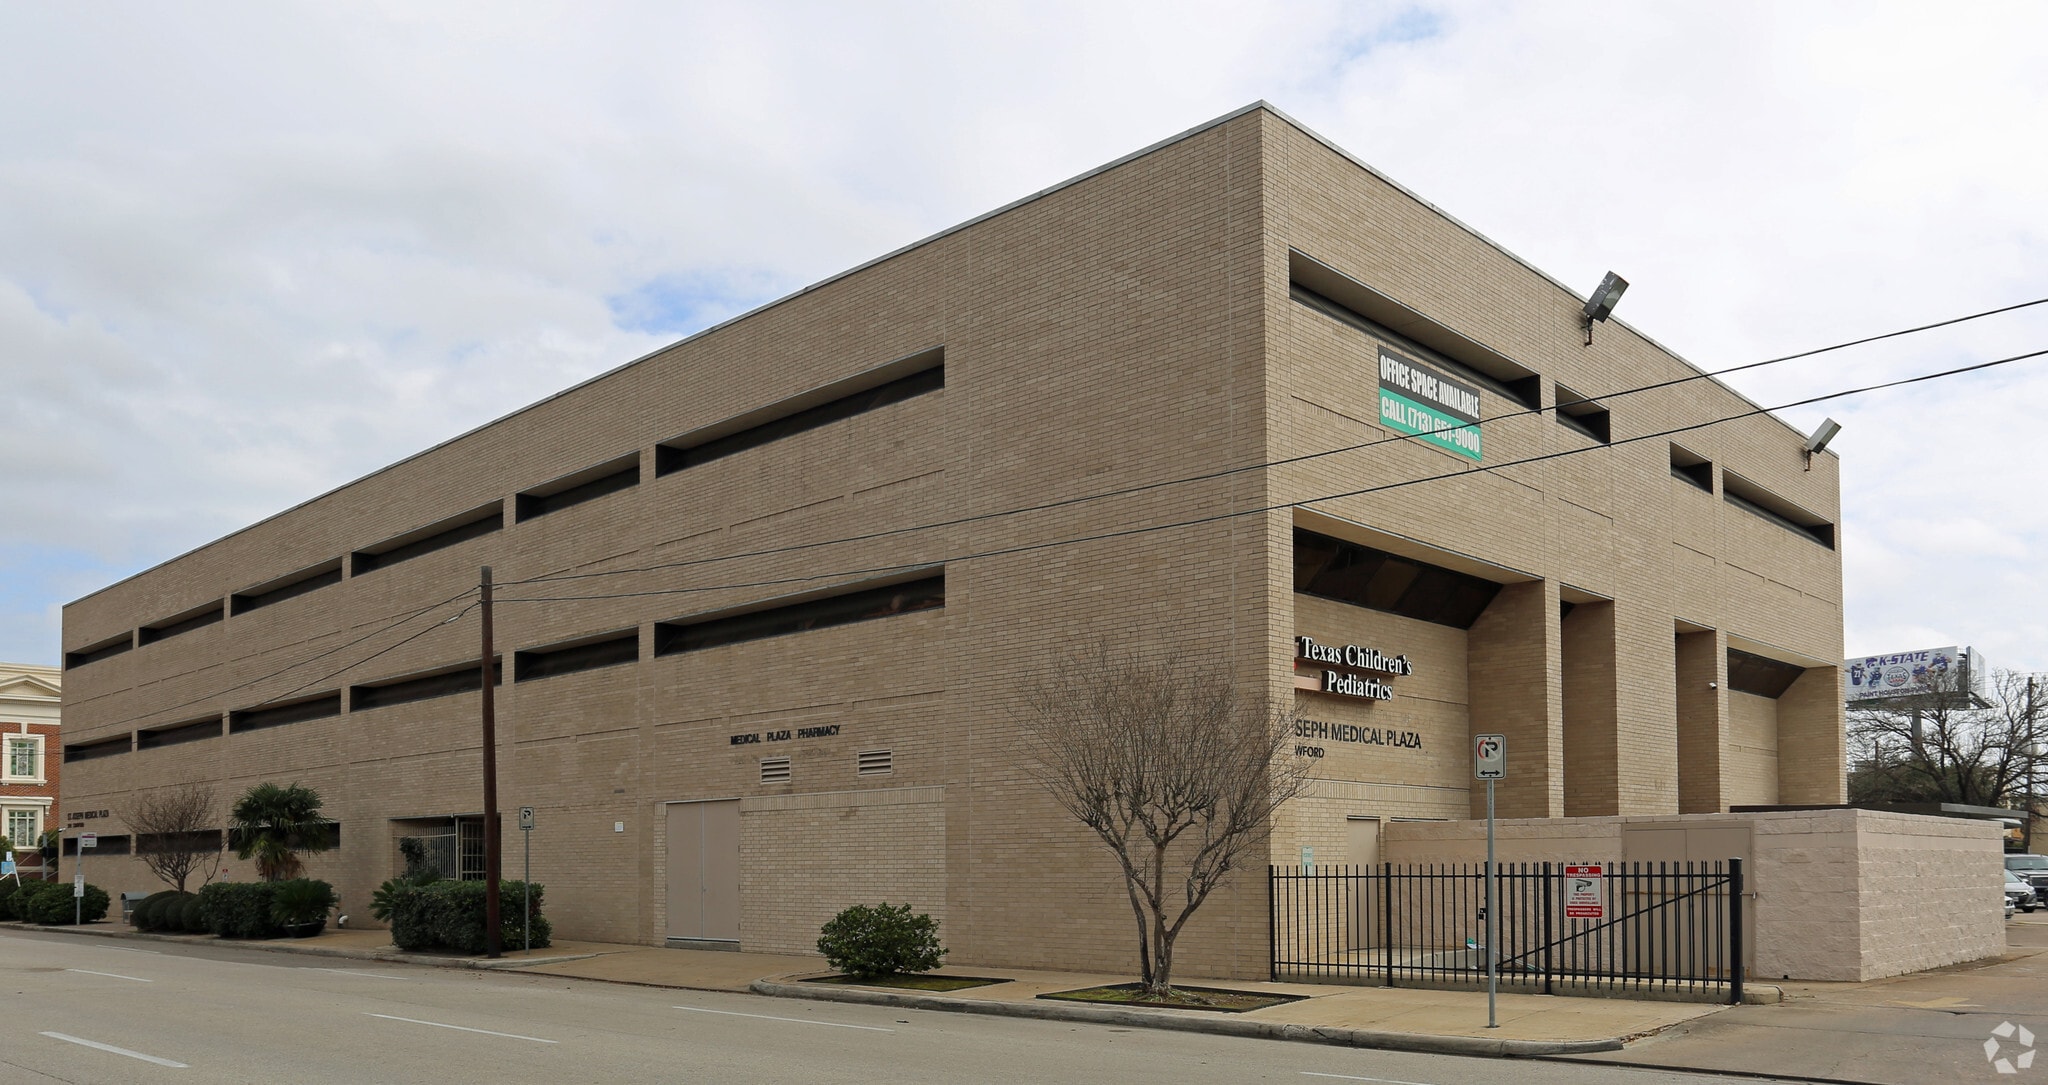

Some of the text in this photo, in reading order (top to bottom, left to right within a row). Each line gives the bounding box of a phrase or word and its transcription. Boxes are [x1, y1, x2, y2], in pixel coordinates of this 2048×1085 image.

[1380, 355, 1479, 419] OFFICE SPACE AVAILABLE
[1381, 396, 1479, 453] CALL (713) 651-9000
[1301, 636, 1412, 676] Texas Children's
[1879, 651, 1929, 666] K-STATE
[1326, 670, 1393, 700] Pediatrics
[730, 725, 840, 745] MEDICAL PLAZA PHARMACY
[1295, 719, 1422, 749] SEPH MEDICAL PLAZA
[1294, 745, 1325, 758] WFORD
